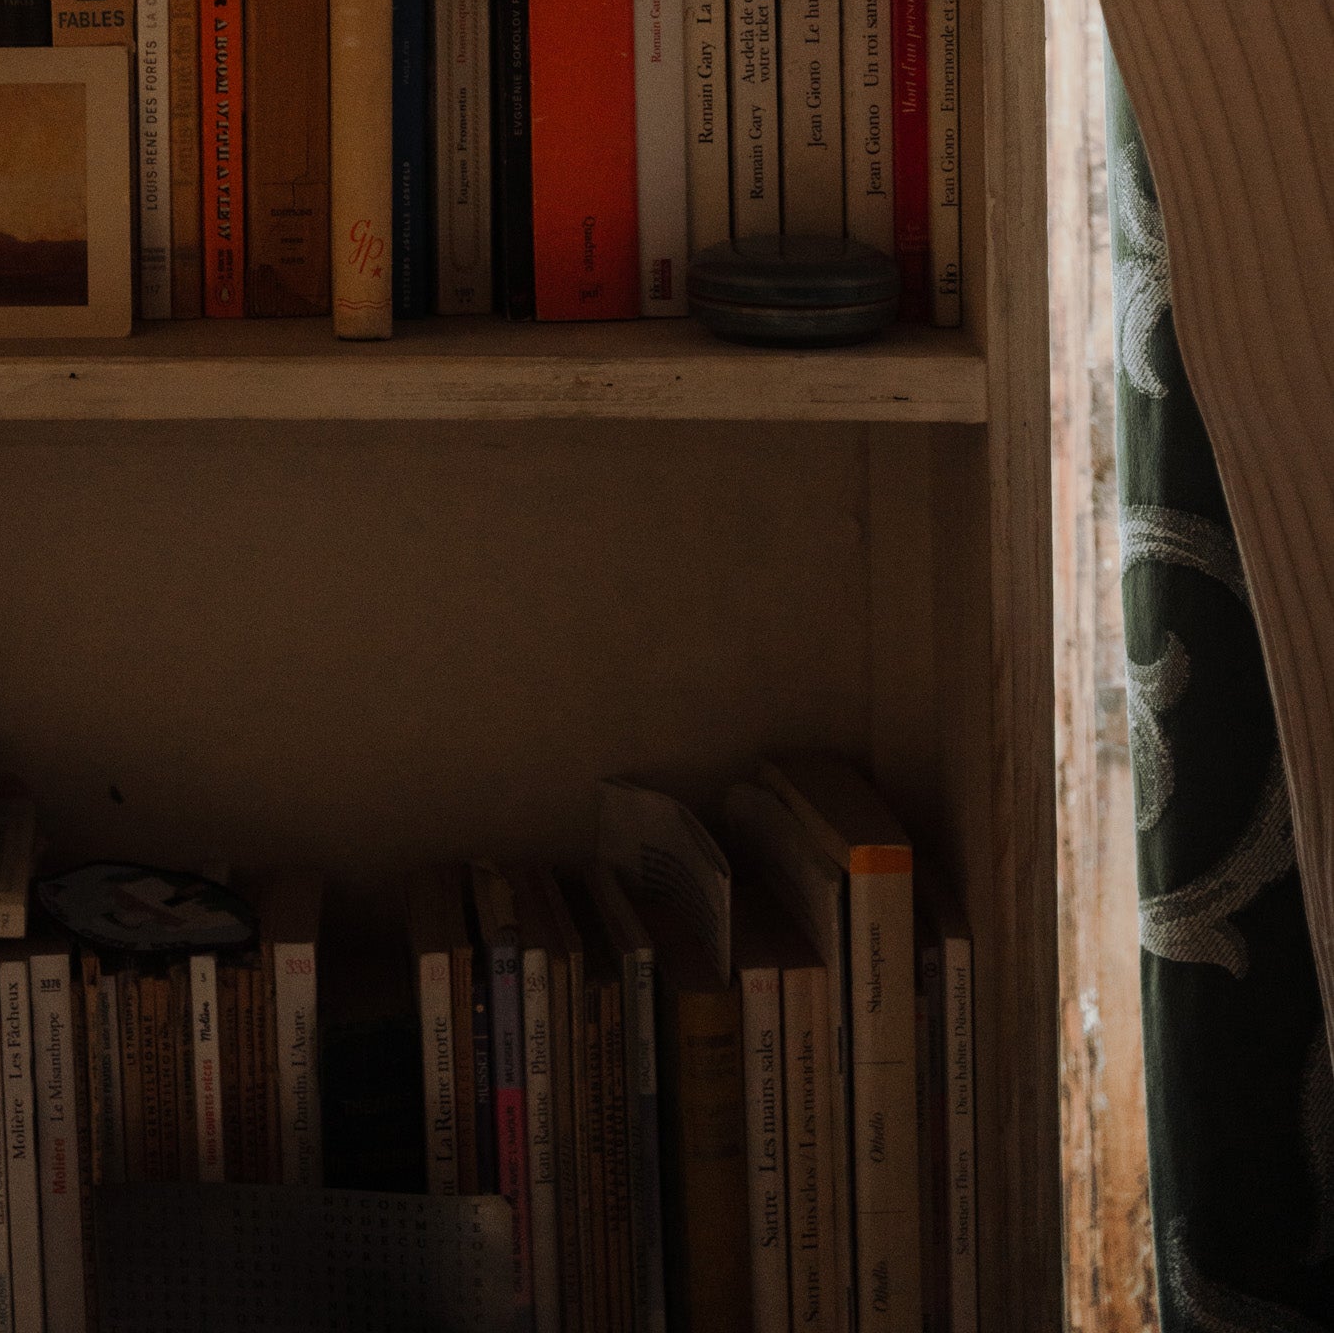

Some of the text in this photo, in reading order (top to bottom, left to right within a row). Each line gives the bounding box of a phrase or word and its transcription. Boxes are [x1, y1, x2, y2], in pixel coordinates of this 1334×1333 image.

[58, 10, 125, 29] FABLES
[696, 3, 712, 25] La
[942, 7, 955, 20] et
[806, 24, 821, 43] Le
[863, 34, 879, 57] roi
[697, 42, 718, 79] Gary
[863, 61, 879, 88] Un
[939, 24, 955, 112] Ennemonde
[808, 60, 823, 108] Giono
[698, 83, 715, 144] Romain
[807, 113, 825, 148] Jean
[866, 104, 882, 155] Giono
[940, 128, 955, 171] Giono
[866, 161, 884, 196] Jean
[941, 175, 957, 208] Jean
[938, 264, 957, 295] folio
[6, 981, 27, 1160] Molière Les Fâcheux
[48, 1011, 67, 1194] Molière Le Misanthrope
[530, 1019, 554, 1185] Jean Racine Phèdre
[755, 1029, 779, 1248] Sartre Les mains sales
